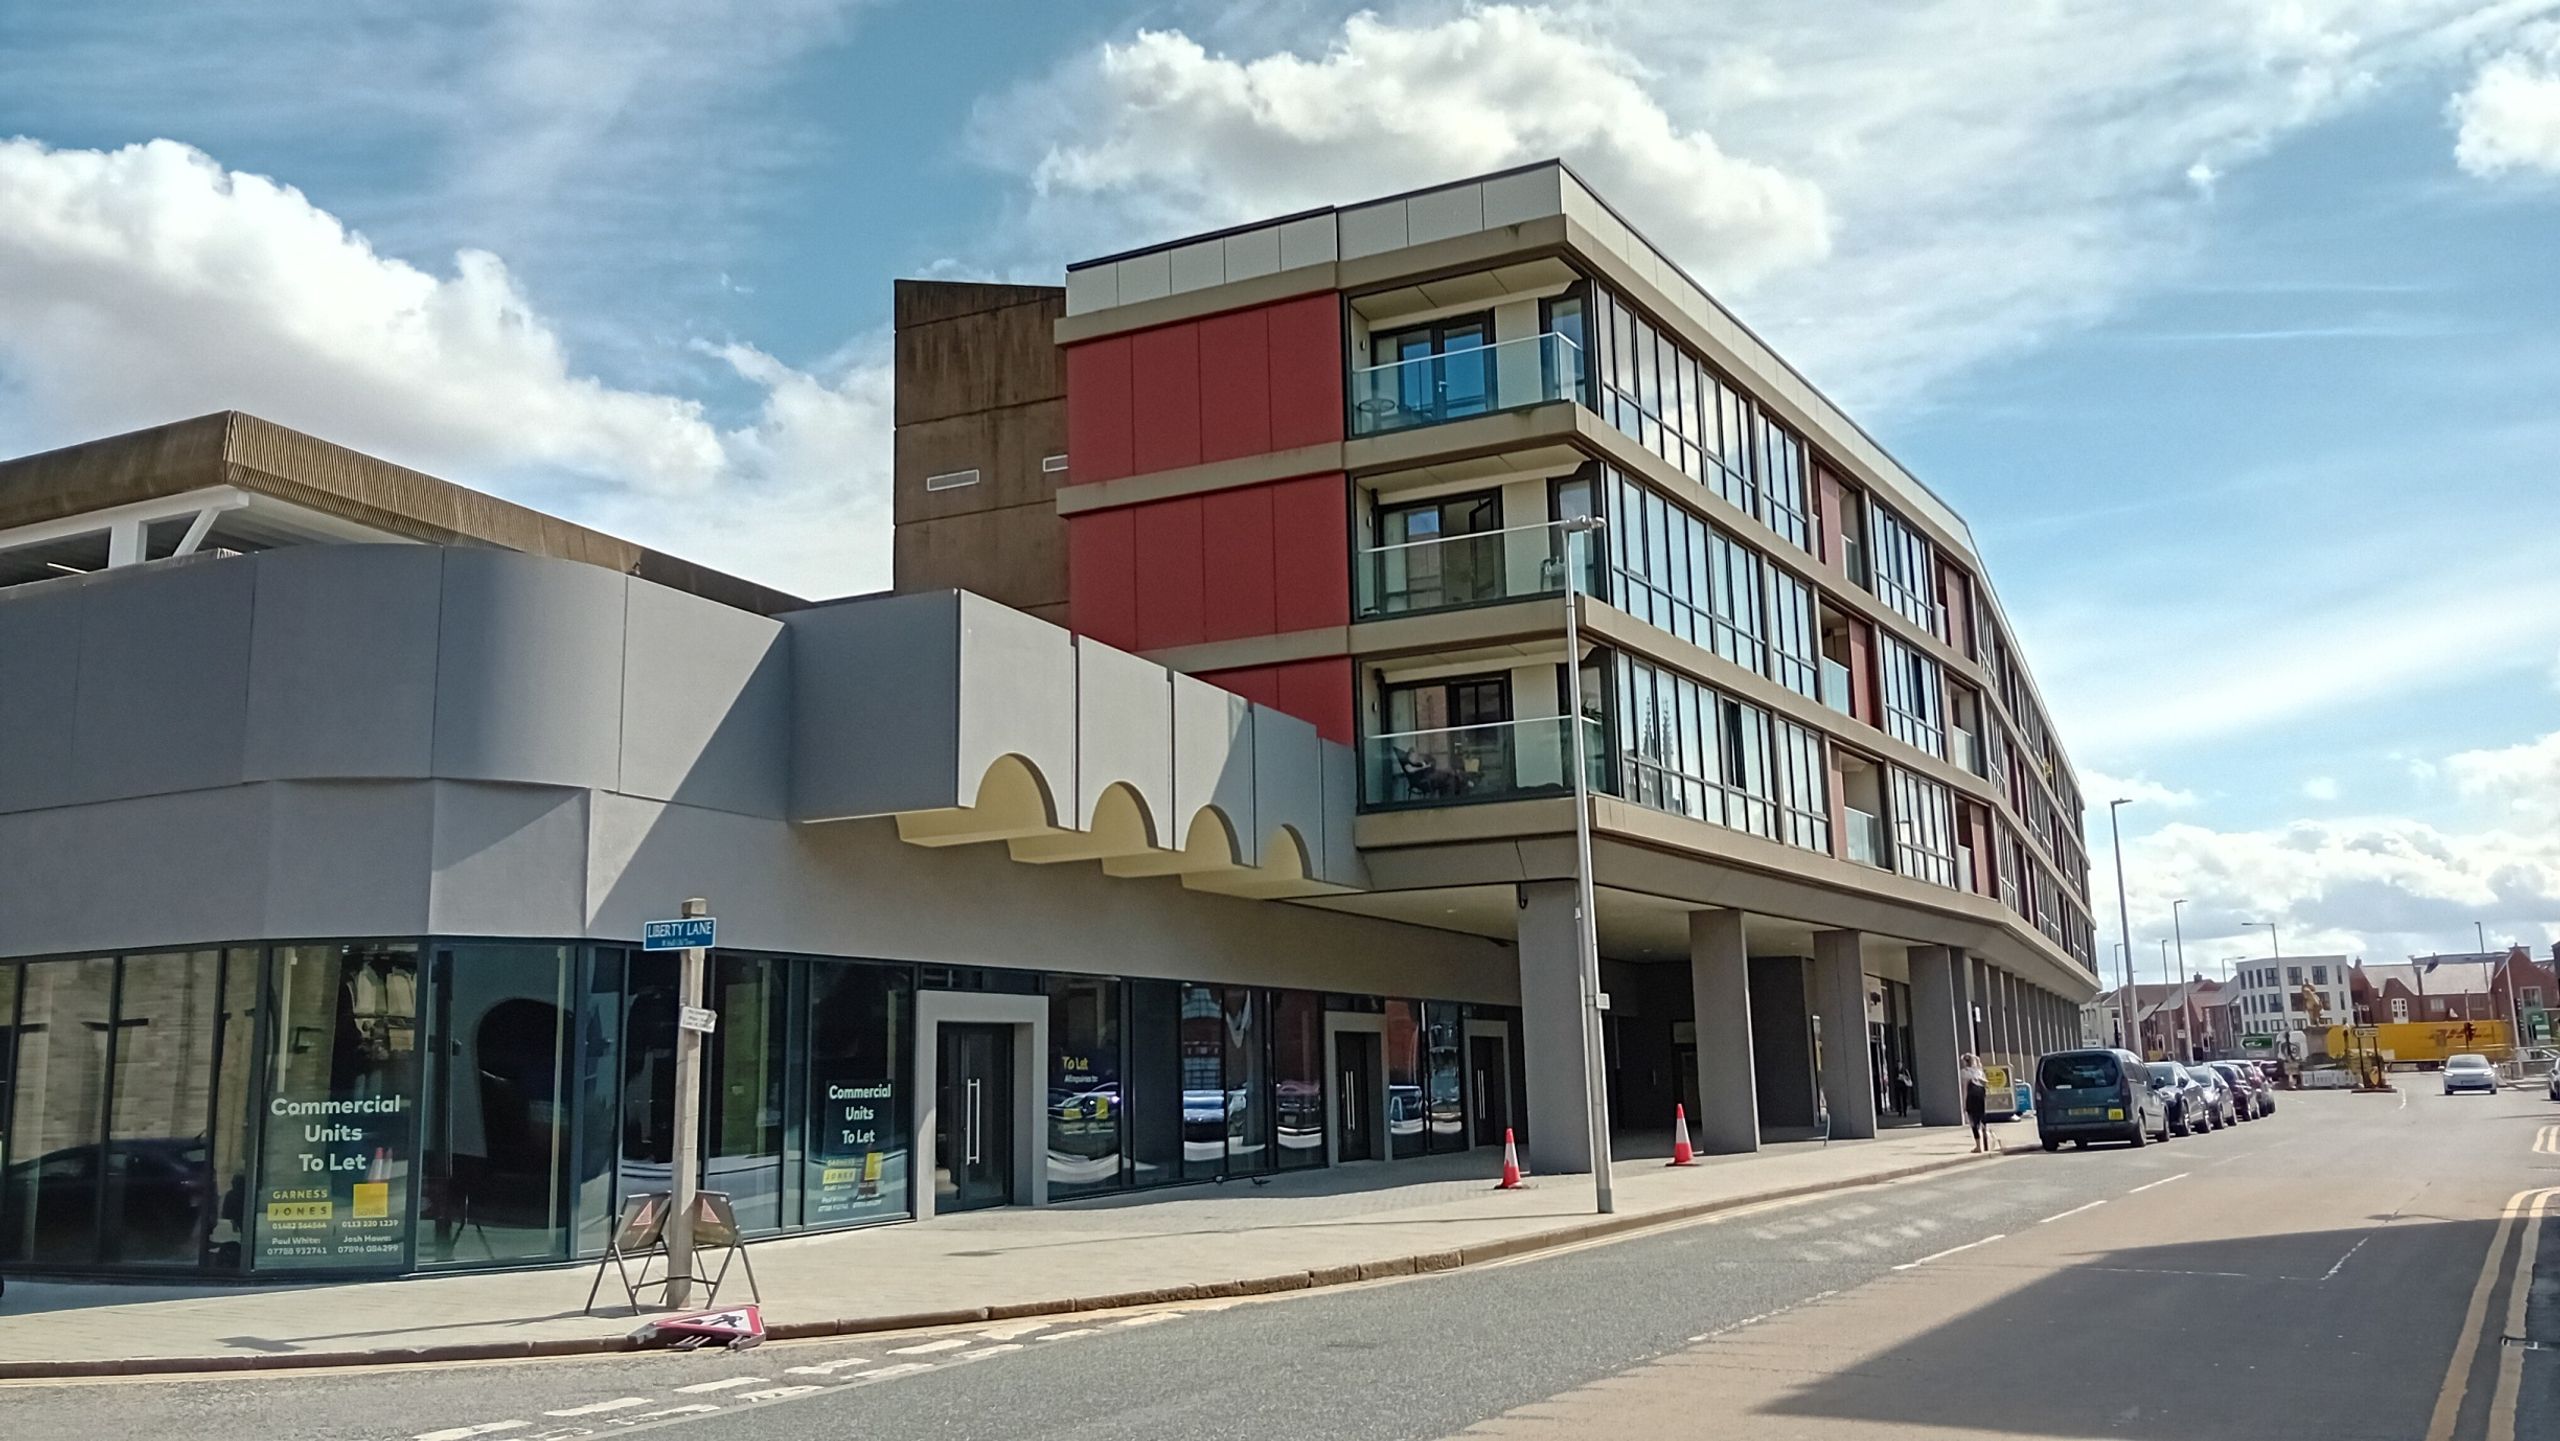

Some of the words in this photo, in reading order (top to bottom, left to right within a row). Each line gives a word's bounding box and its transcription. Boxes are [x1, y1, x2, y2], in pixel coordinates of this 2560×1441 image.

[647, 923, 684, 938] LIBERTY
[686, 921, 713, 936] LANE
[1061, 1056, 1075, 1070] To
[1075, 1057, 1088, 1070] Let
[829, 1083, 892, 1099] Commercial
[271, 1094, 400, 1116] Commercial
[845, 1106, 874, 1121] Units
[305, 1124, 363, 1142] Units
[842, 1130, 855, 1144] To
[857, 1129, 875, 1143] Let
[299, 1154, 324, 1171] To
[330, 1153, 367, 1171] Let
[272, 1189, 328, 1199] GARNESS
[273, 1206, 328, 1216] JONES
[343, 1235, 363, 1243] Josh
